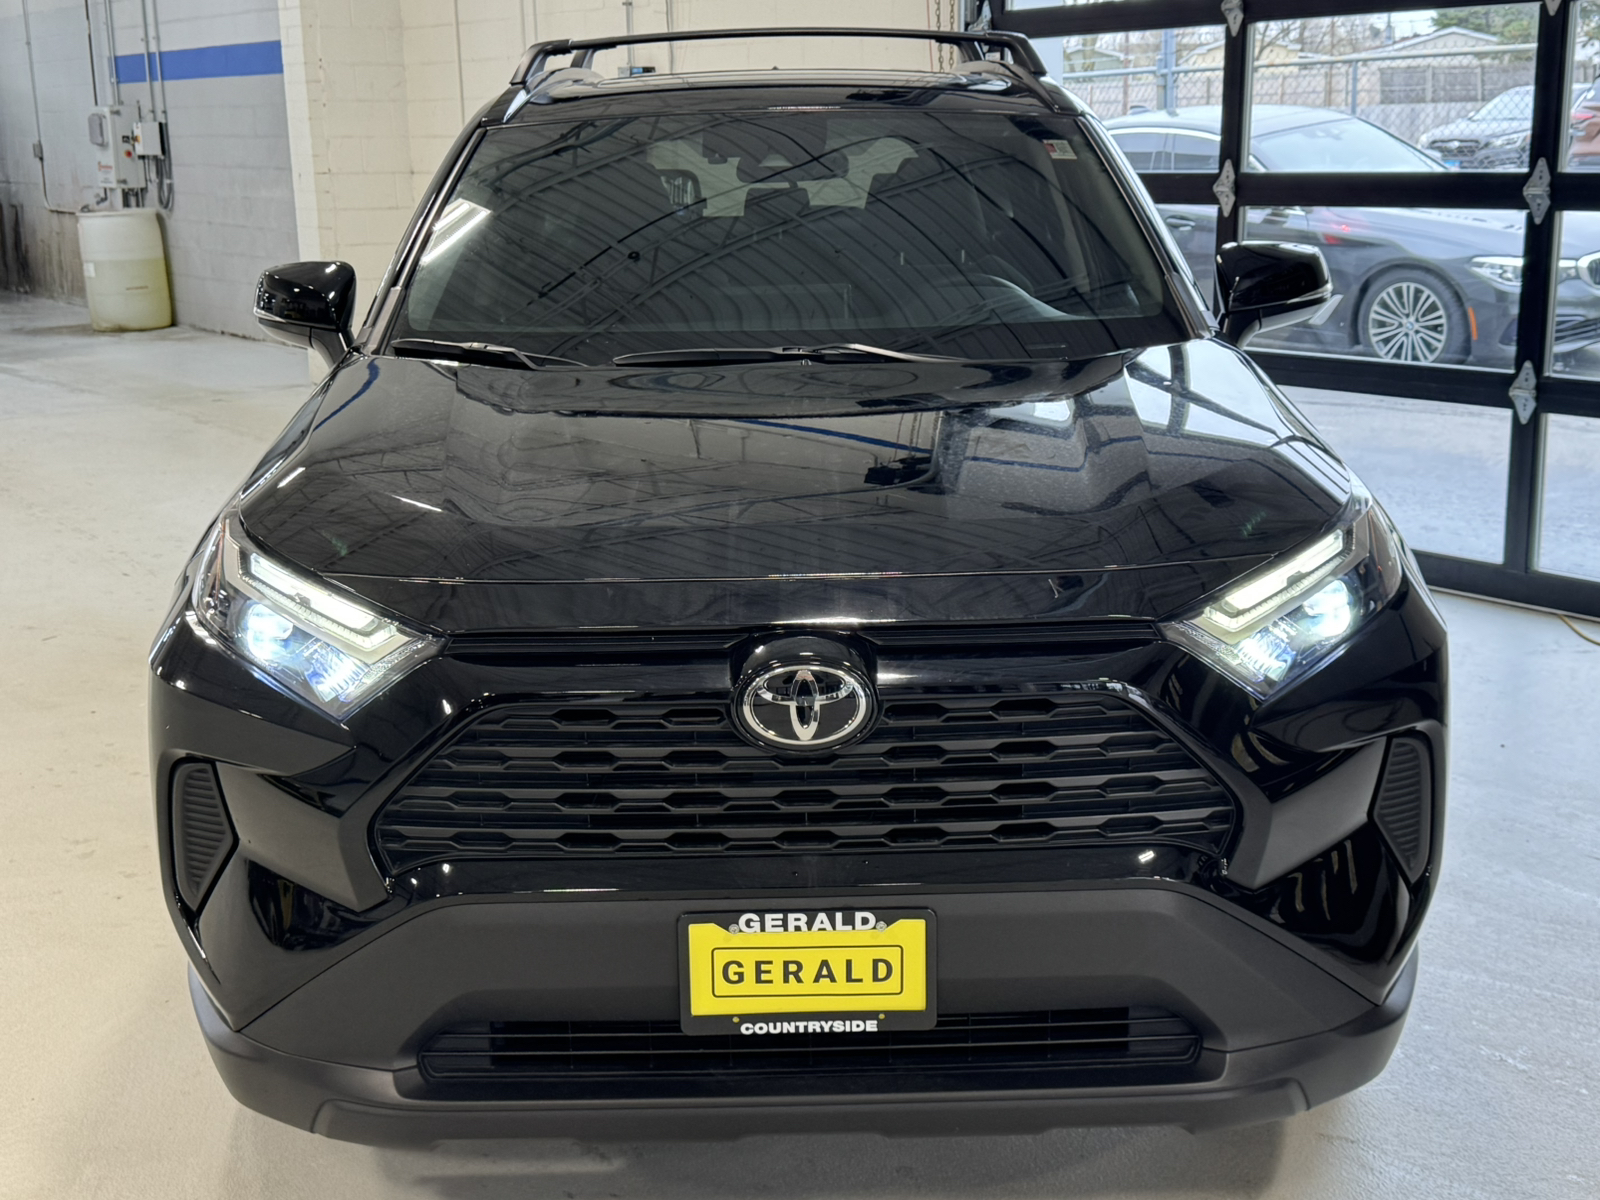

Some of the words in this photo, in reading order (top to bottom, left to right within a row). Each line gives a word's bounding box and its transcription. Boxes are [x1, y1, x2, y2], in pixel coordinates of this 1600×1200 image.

[738, 911, 876, 934] GERALD
[722, 958, 894, 985] GERALD
[740, 1020, 878, 1035] COUNTRYSIDE
